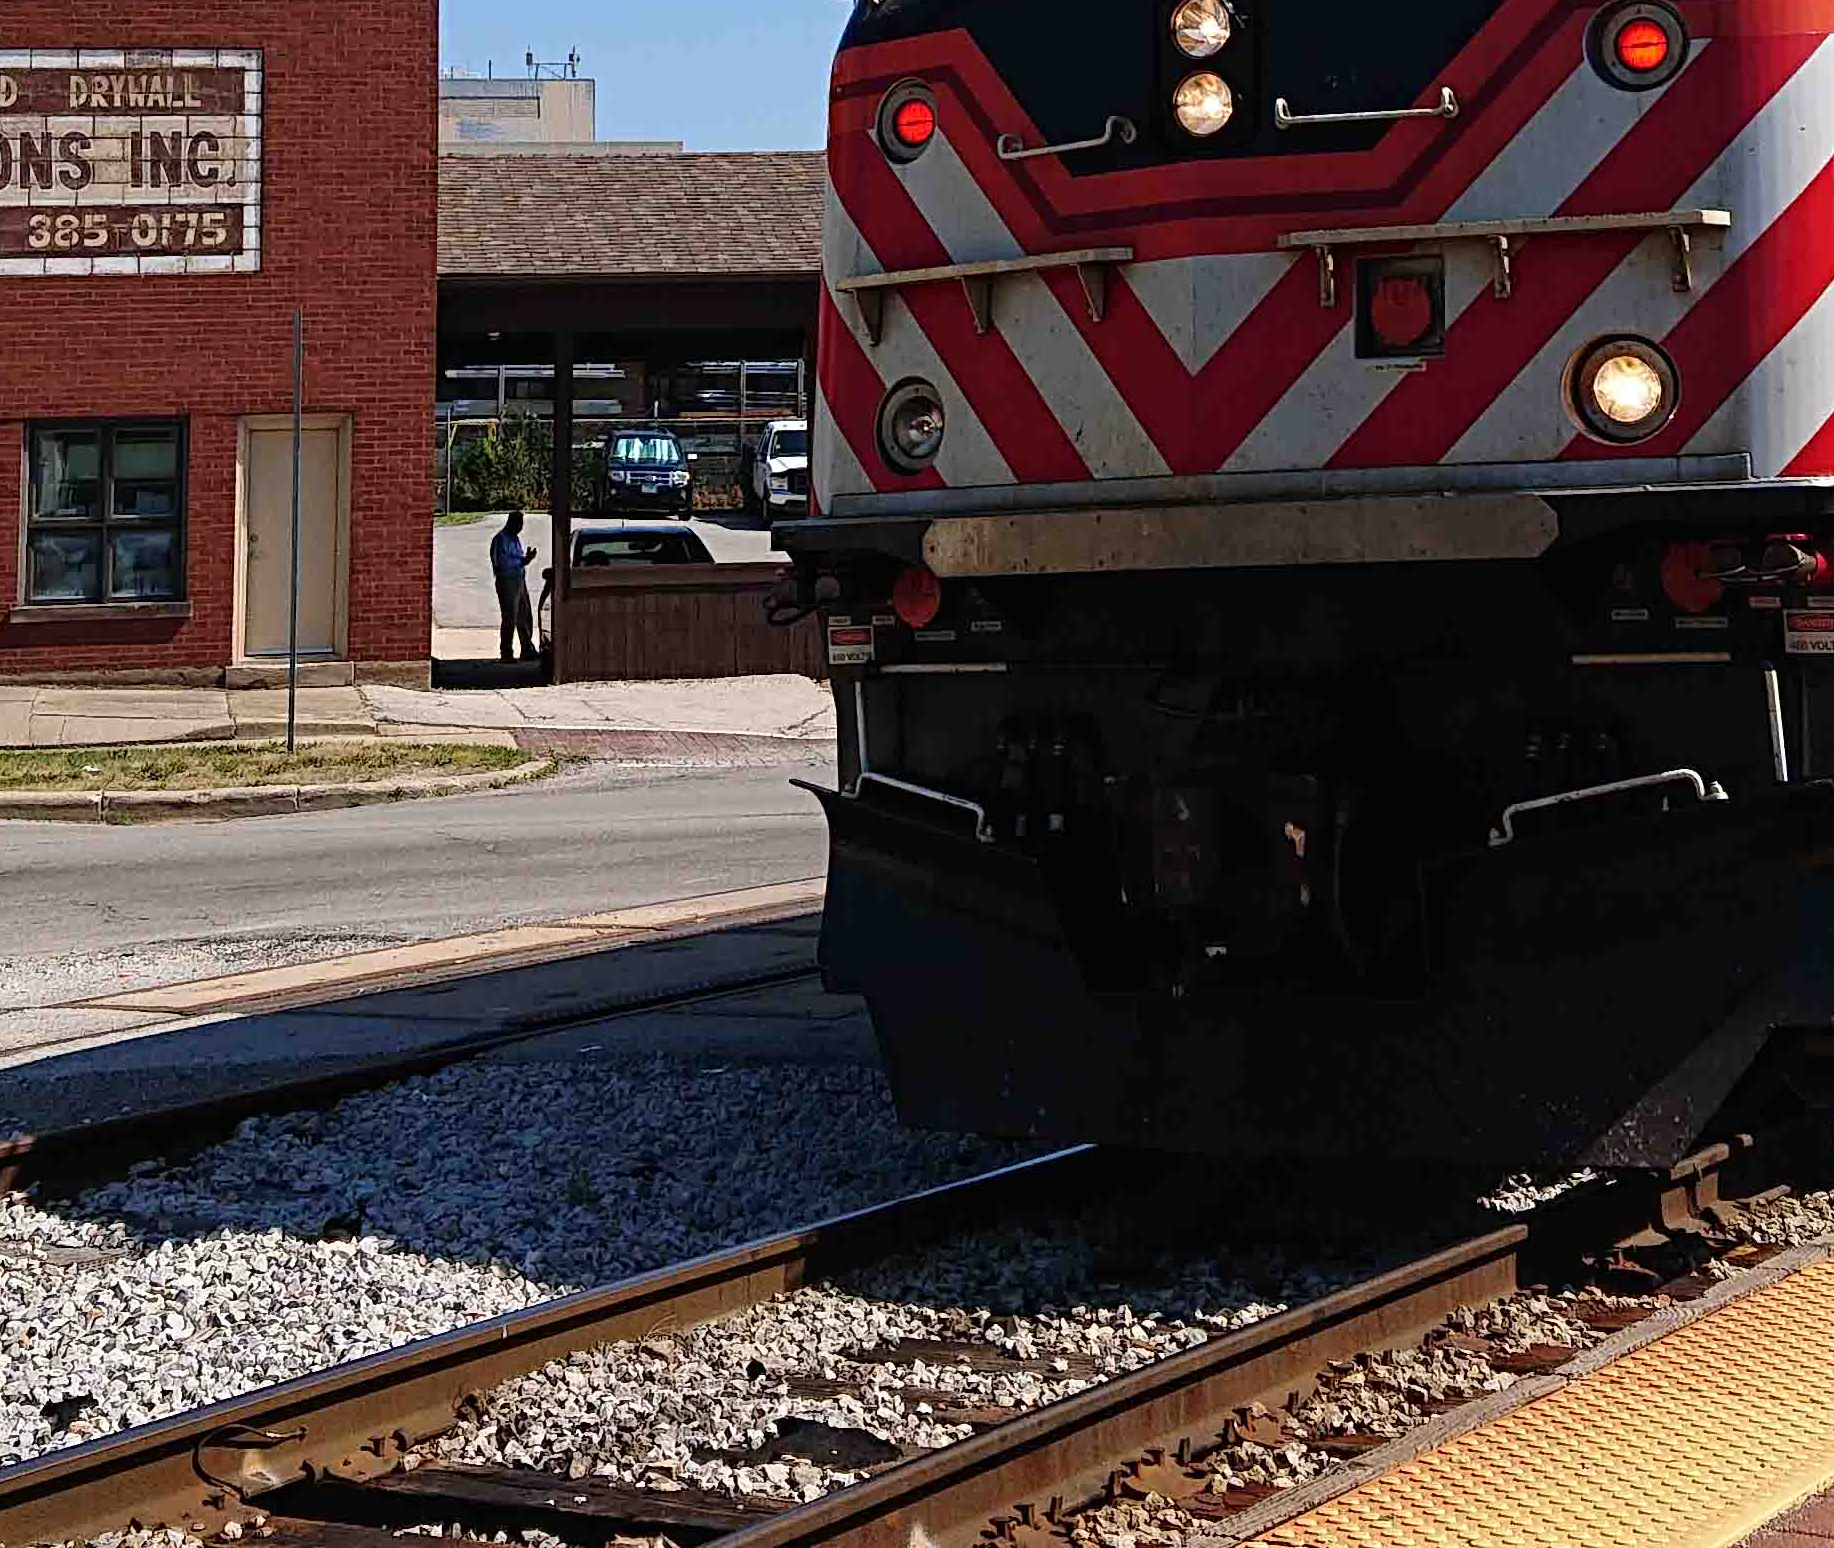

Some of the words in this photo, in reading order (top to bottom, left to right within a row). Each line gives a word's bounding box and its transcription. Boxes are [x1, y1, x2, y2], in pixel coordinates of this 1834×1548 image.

[69, 74, 202, 108] DRYWALL
[130, 130, 237, 189] INC.
[28, 212, 227, 249] 385-0175
